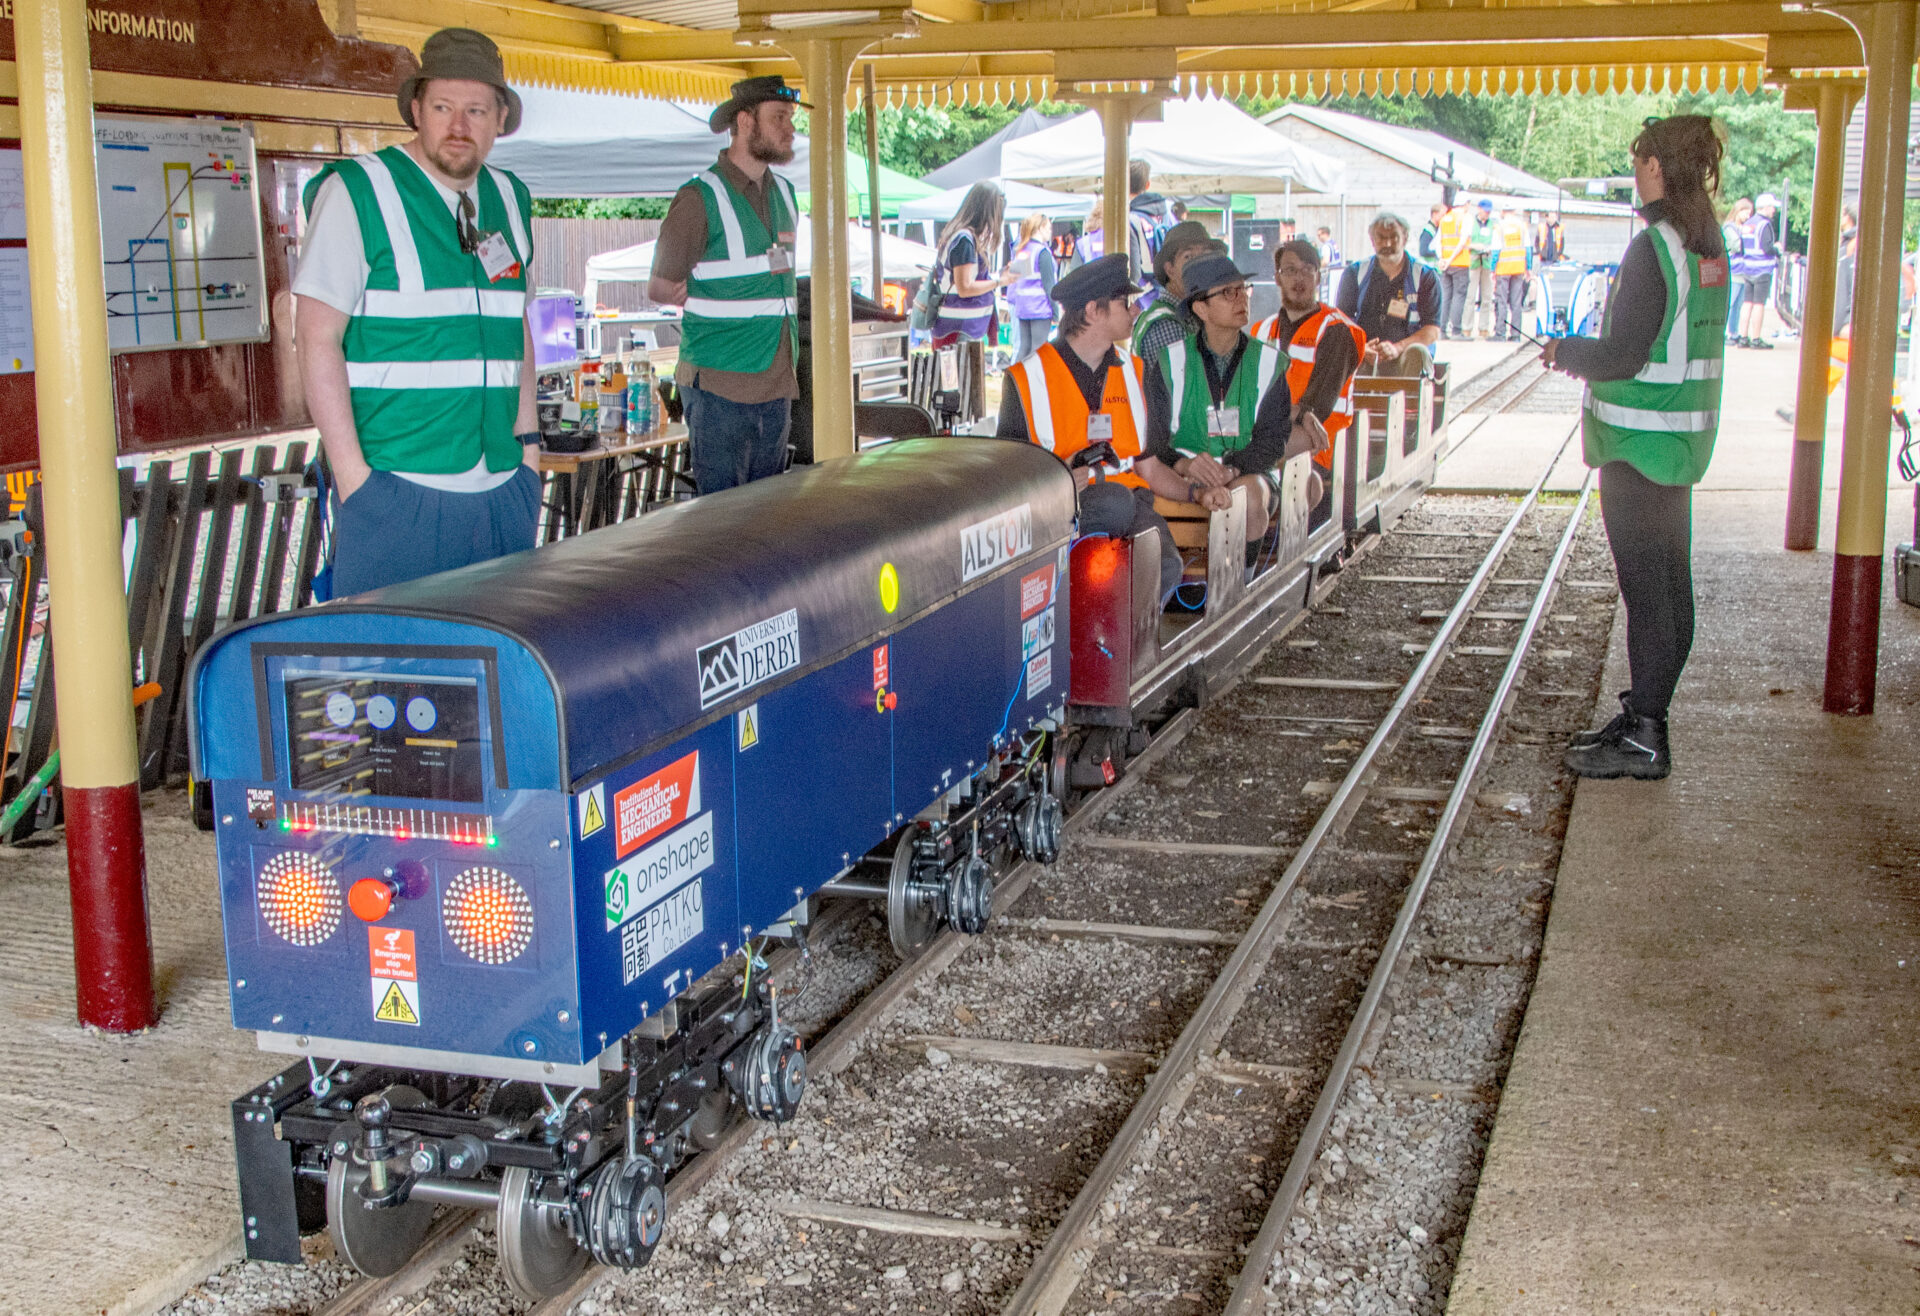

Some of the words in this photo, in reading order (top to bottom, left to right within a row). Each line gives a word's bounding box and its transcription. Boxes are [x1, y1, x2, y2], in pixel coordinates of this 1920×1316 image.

[88, 8, 195, 43] NFORMATION
[964, 511, 1031, 575] ALSTOM
[738, 615, 786, 647] UNIVERSITY
[787, 610, 797, 627] OF
[740, 629, 798, 687] DERBY
[620, 786, 653, 811] Institution
[653, 779, 660, 794] of
[620, 782, 680, 829] MECHANICAL
[621, 803, 671, 846] ENGINEERS
[637, 830, 709, 893] onshape
[651, 881, 702, 943] PATKO
[374, 949, 411, 961] Emergency
[664, 936, 677, 954] Co.
[678, 920, 694, 943] Ltd.
[374, 967, 391, 976] push
[392, 969, 413, 978] button
[386, 960, 401, 968] stop
